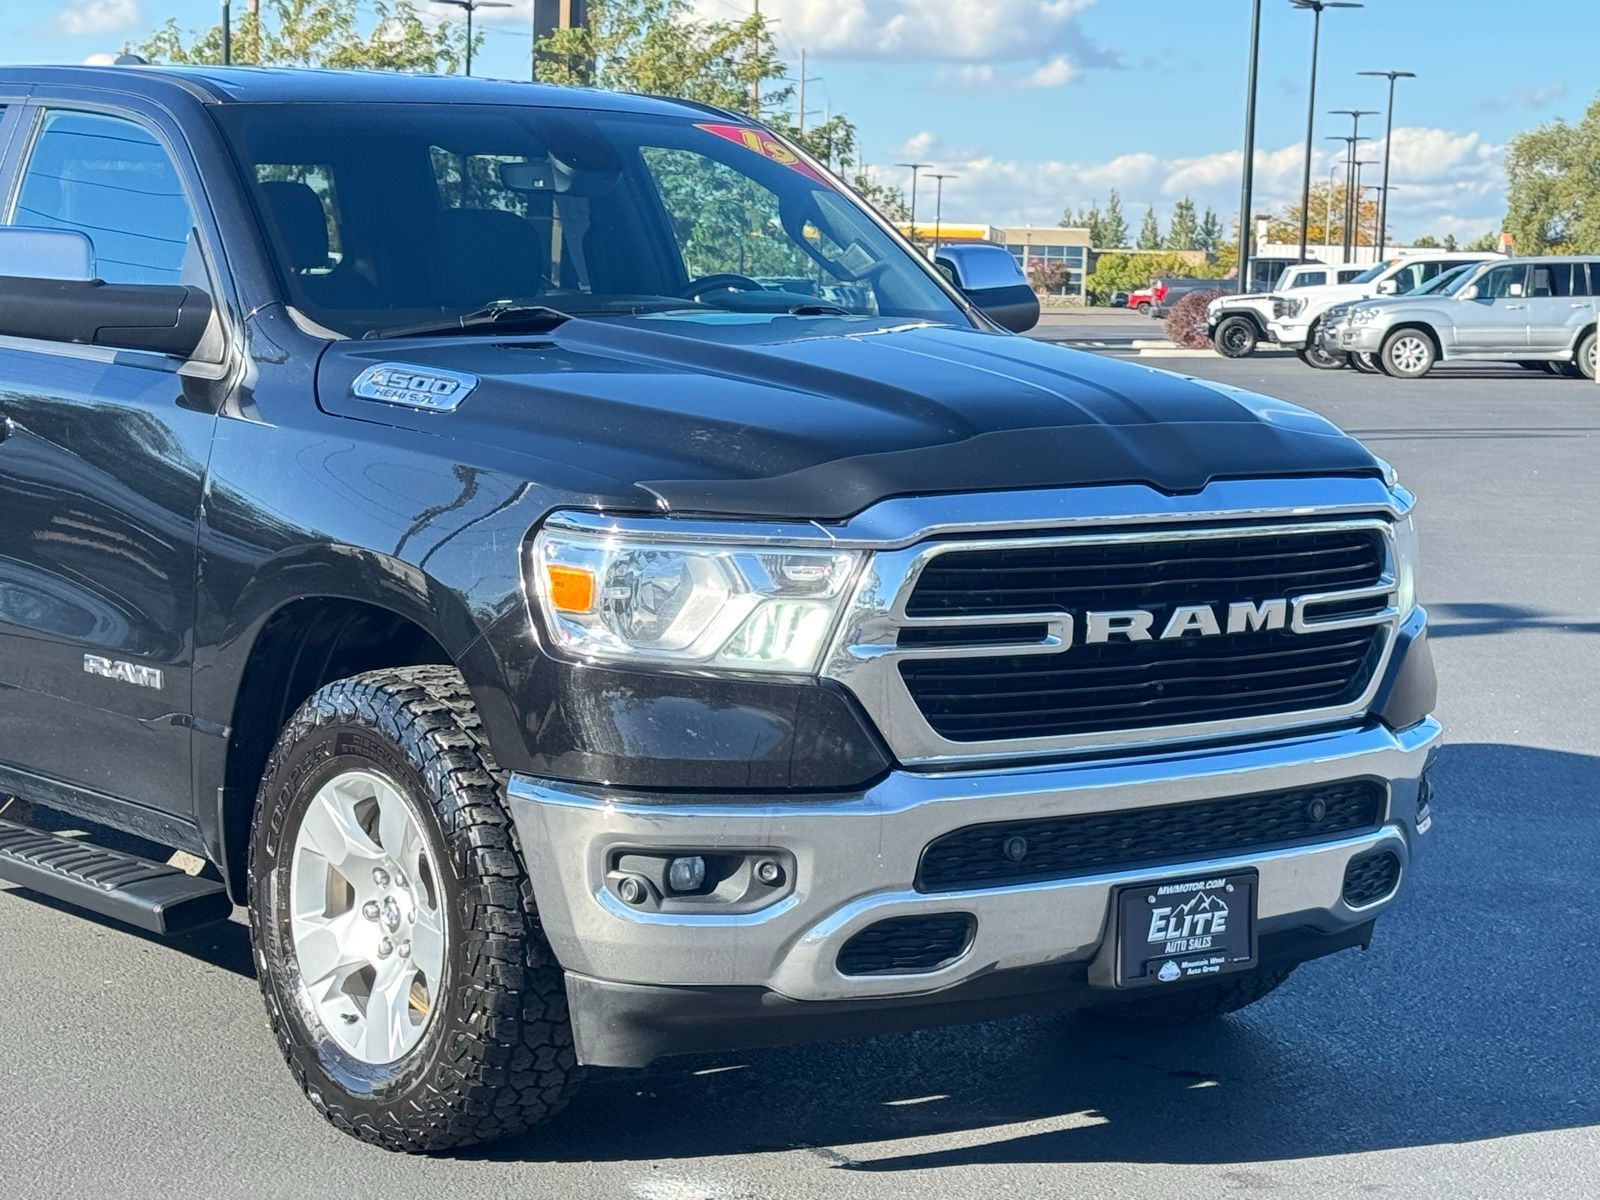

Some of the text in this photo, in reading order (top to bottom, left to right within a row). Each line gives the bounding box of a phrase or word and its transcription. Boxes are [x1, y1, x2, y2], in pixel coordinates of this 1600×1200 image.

[371, 369, 460, 396] 1500
[374, 388, 406, 400] HEMI
[1086, 598, 1287, 644] RAM
[84, 653, 164, 690] RAM
[1157, 879, 1226, 896] MWMOTOR.COM
[1148, 907, 1229, 942] ELITE
[1165, 936, 1212, 954] AUTO SALES
[1181, 958, 1209, 968] Mountain
[1187, 965, 1220, 975] Auto Group
